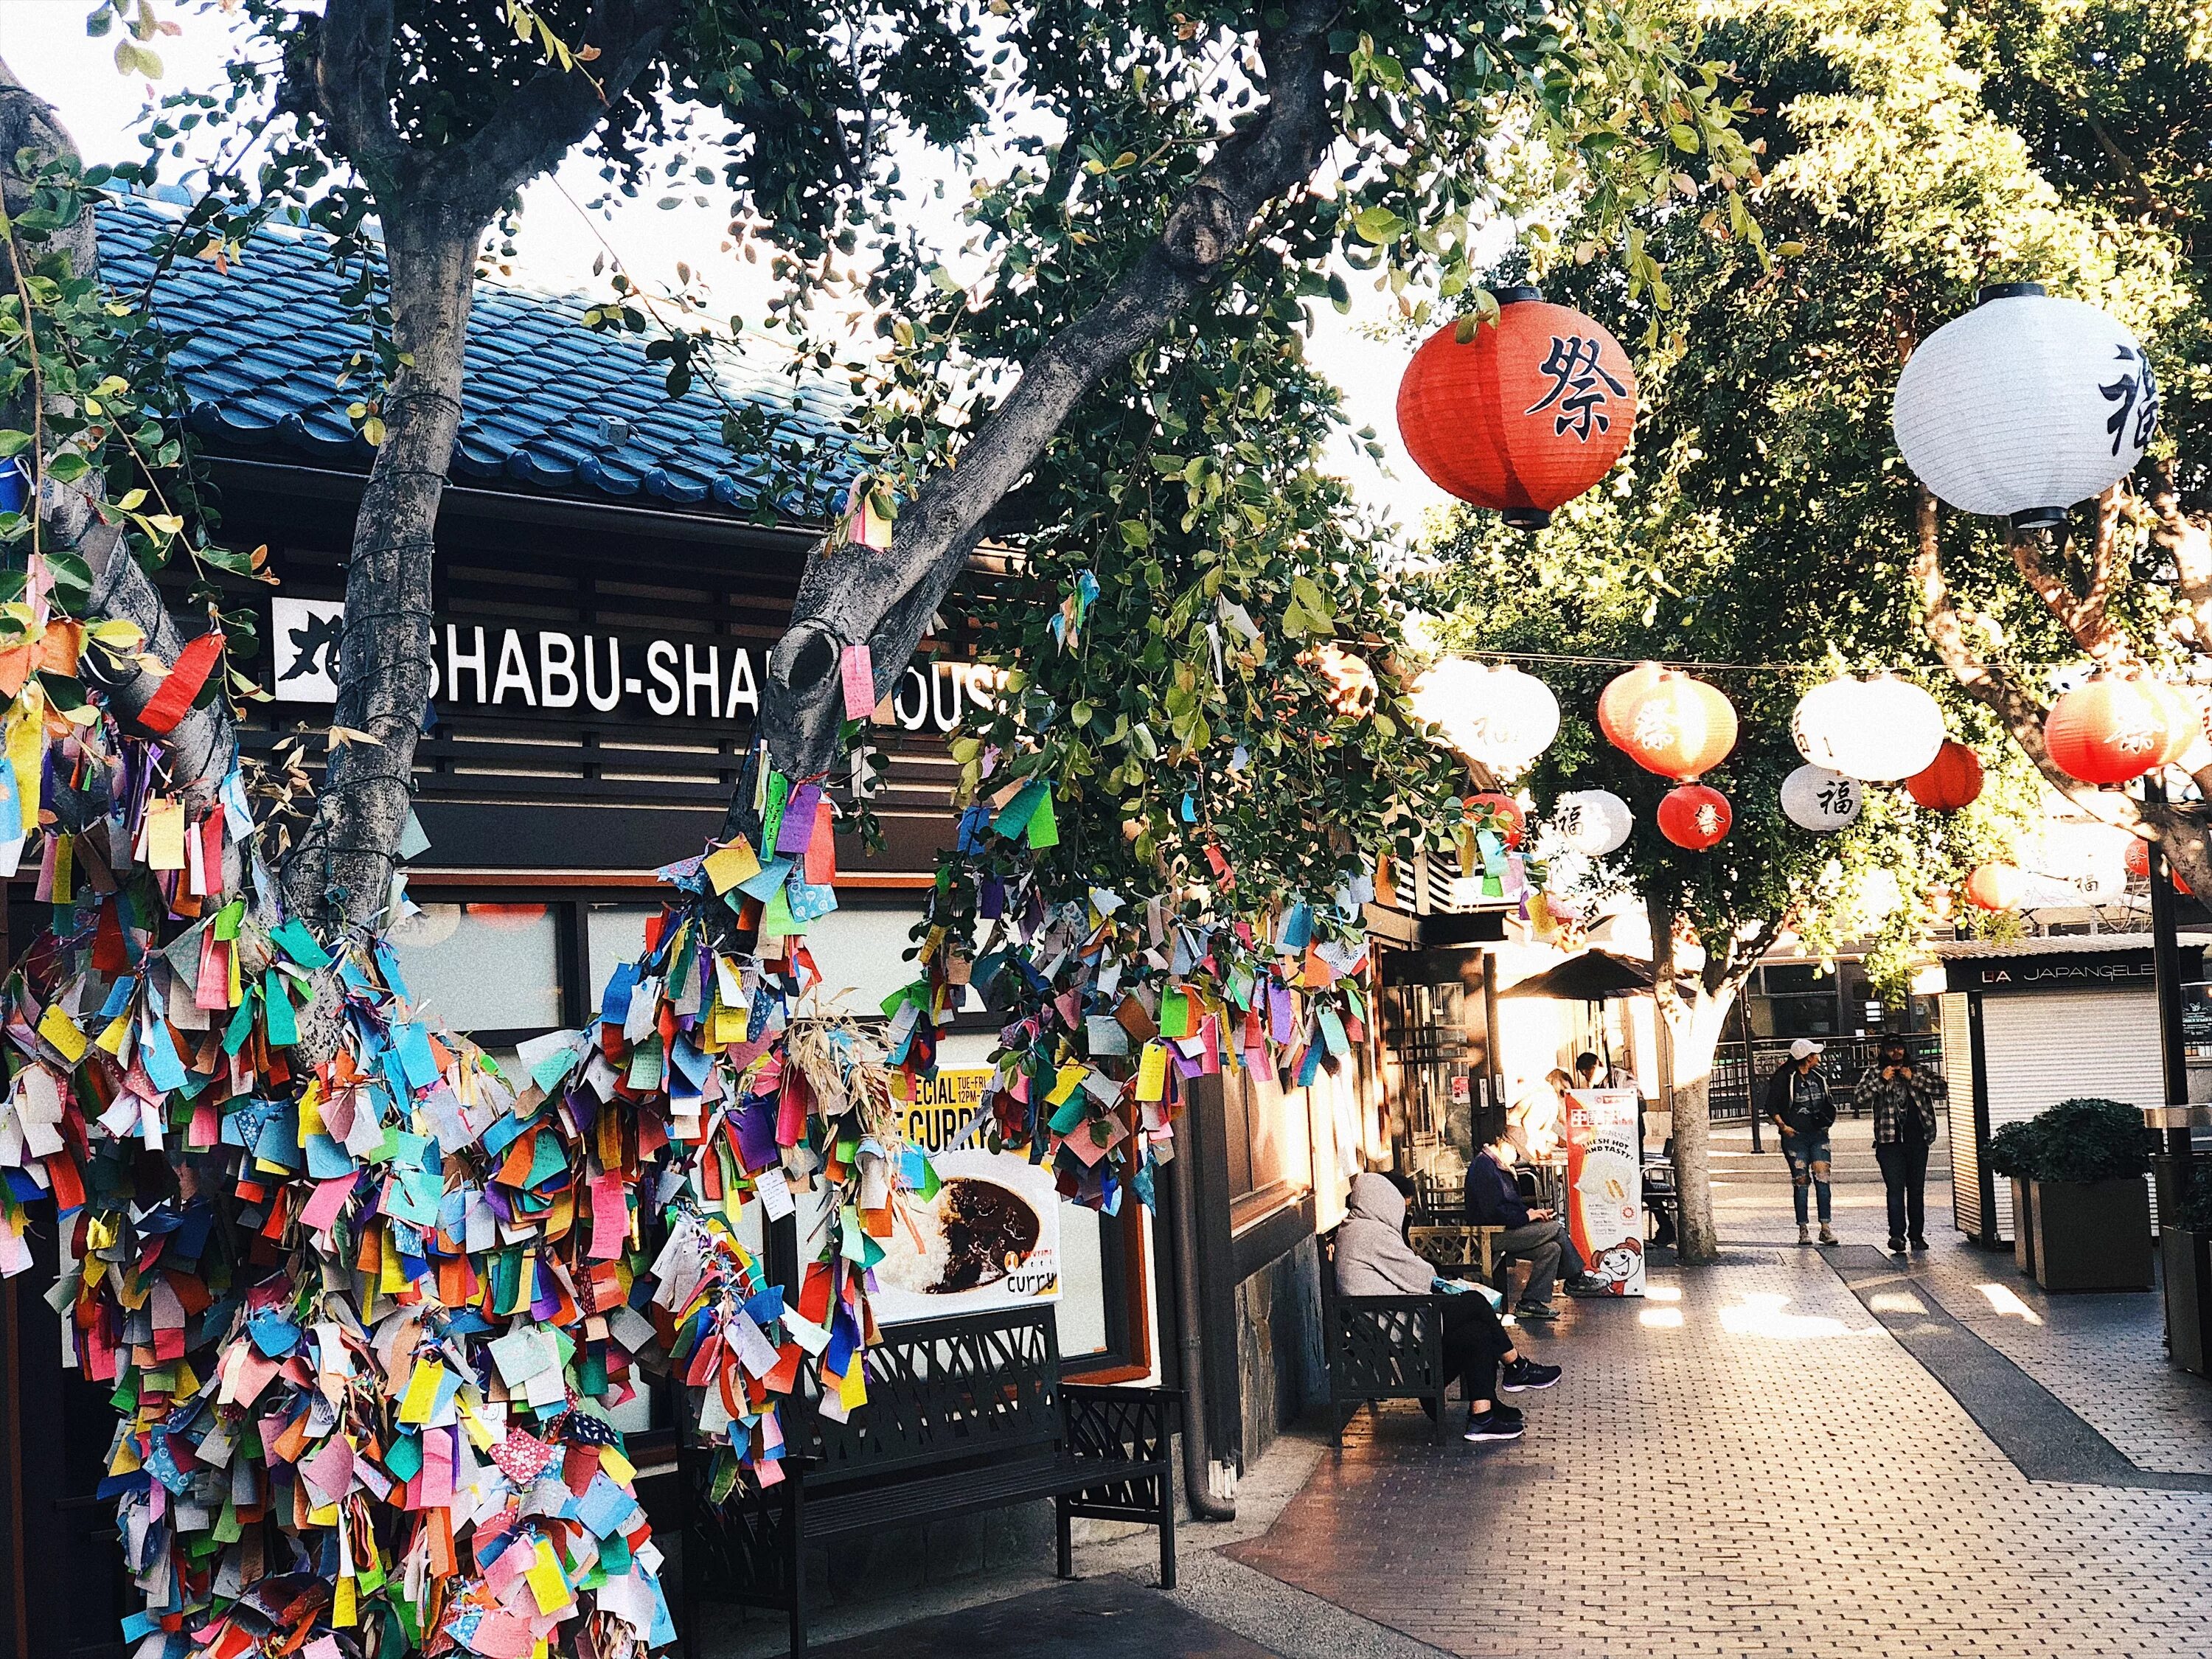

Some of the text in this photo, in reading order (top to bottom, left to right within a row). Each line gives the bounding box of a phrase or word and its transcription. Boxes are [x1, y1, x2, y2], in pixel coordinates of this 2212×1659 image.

[1524, 334, 1628, 444] 祭
[2097, 343, 2160, 456] 福
[429, 624, 772, 718] HABU-SHA
[1817, 780, 1854, 815] 福
[1558, 805, 1584, 838] 福
[1688, 803, 1726, 837] 祭
[1982, 970, 2012, 984] LA
[913, 1076, 956, 1106] ECIAL
[957, 1076, 987, 1089] TUE-FRI
[1585, 1145, 1634, 1161] AND TASTY!
[1612, 1139, 1630, 1150] HOT
[1007, 1272, 1054, 1293] curry
